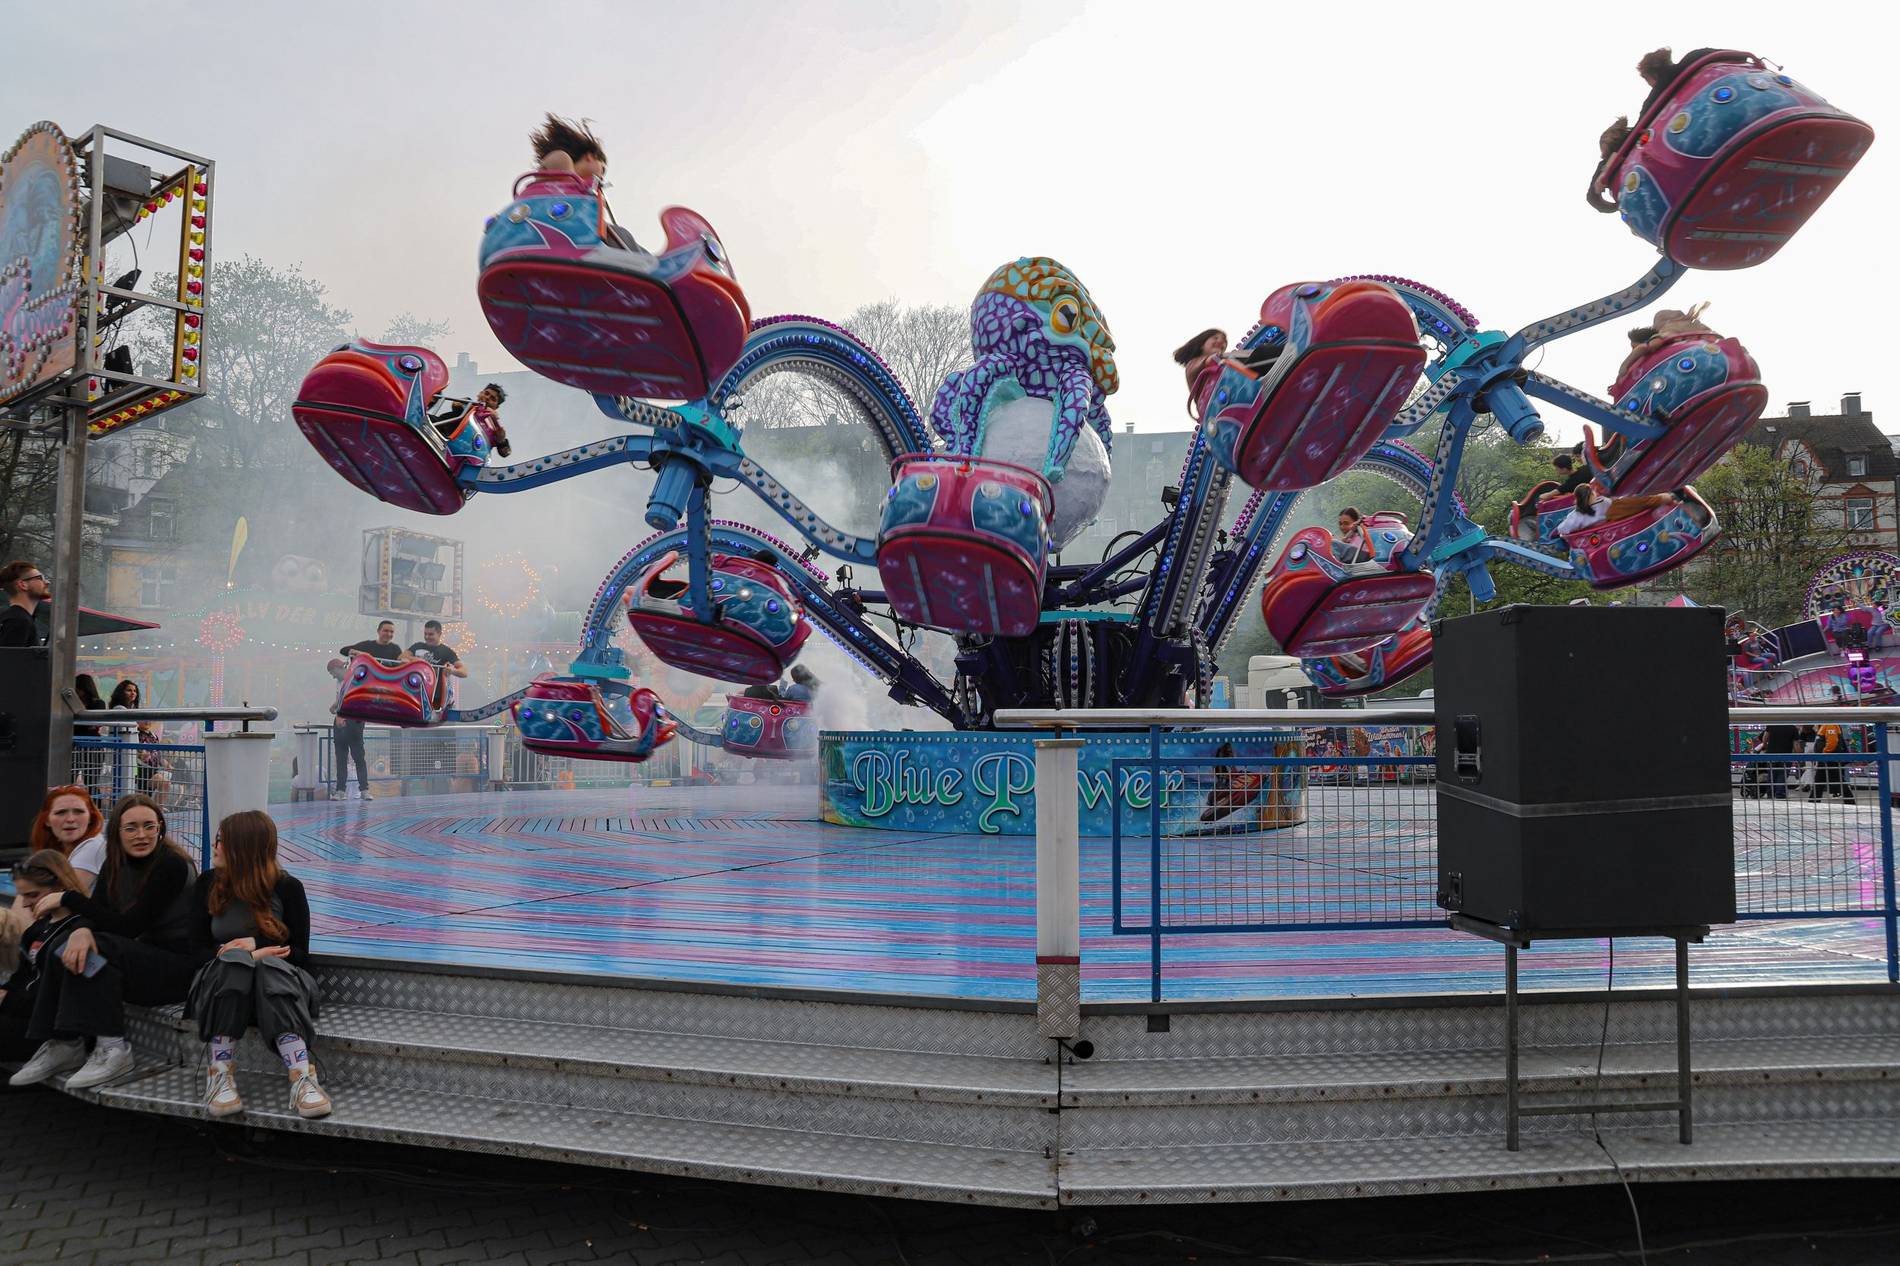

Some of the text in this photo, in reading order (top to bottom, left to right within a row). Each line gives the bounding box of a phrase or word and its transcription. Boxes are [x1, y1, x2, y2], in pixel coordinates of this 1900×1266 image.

[1470, 338, 1480, 349] 3
[700, 414, 711, 426] 2
[853, 750, 1184, 833] Blue Pwer
